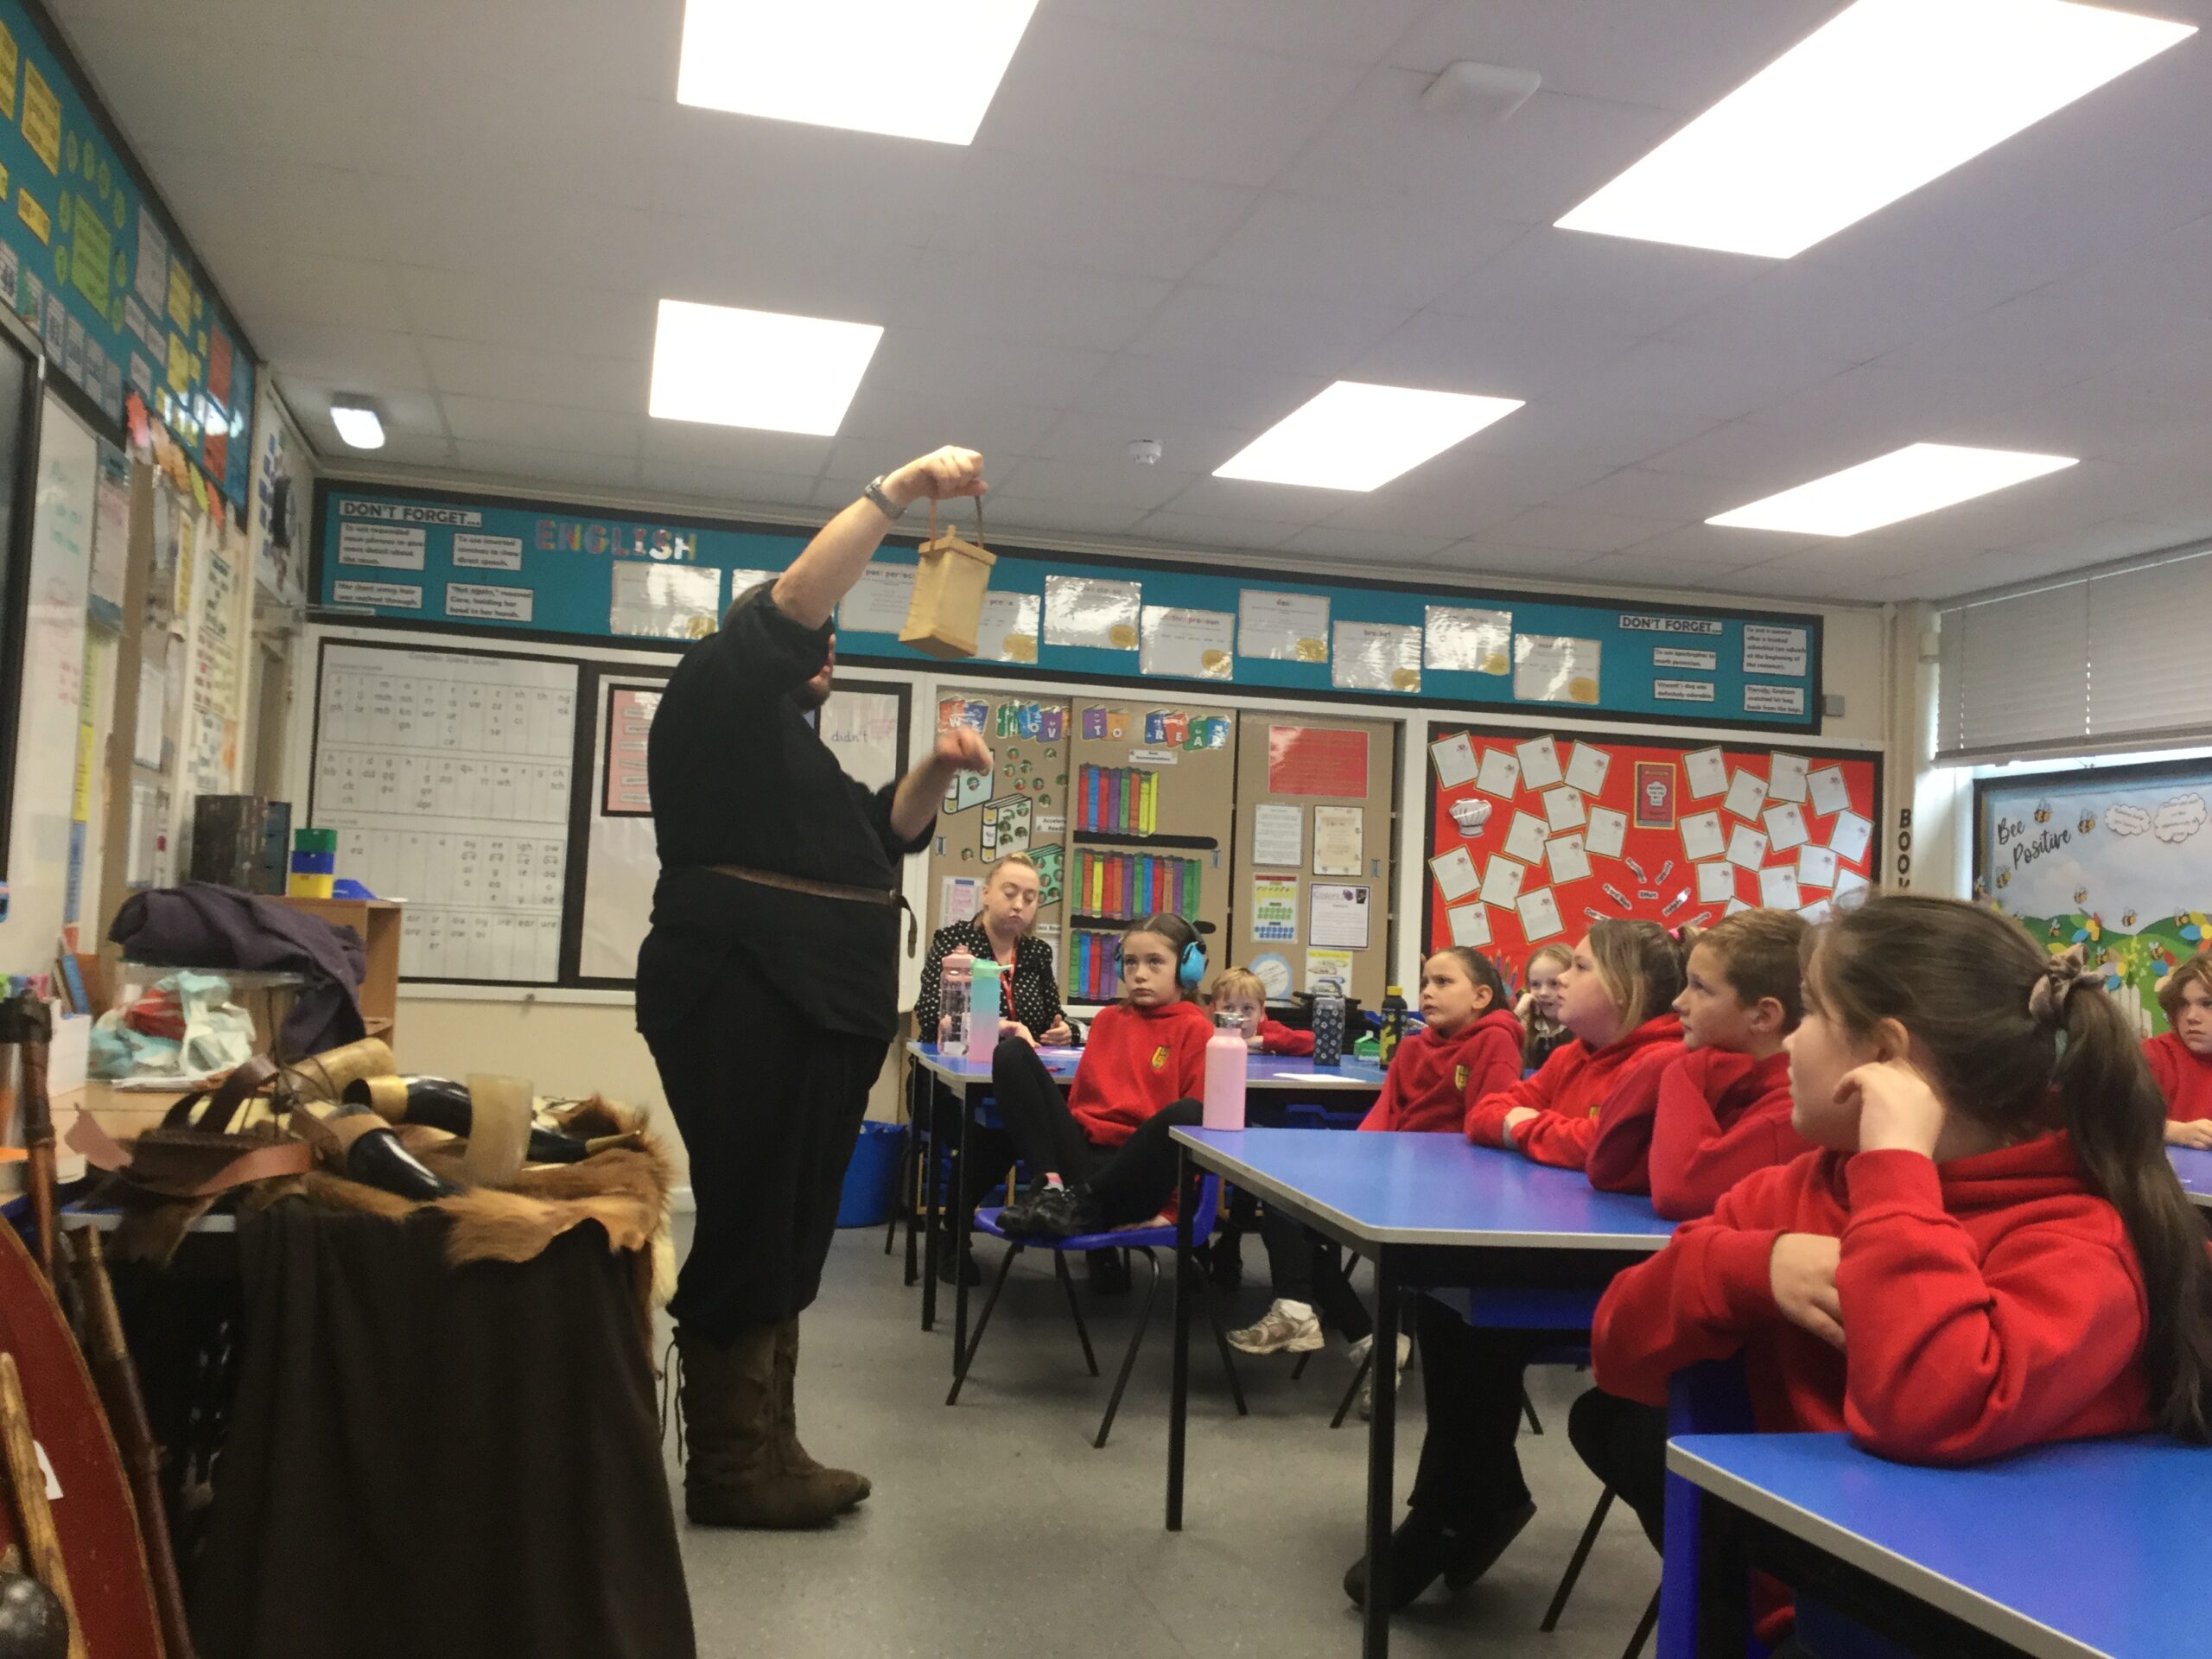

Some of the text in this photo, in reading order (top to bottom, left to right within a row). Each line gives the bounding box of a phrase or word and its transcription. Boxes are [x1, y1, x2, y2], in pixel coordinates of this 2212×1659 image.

[344, 503, 398, 518] DON'T
[536, 520, 696, 560] ENGLISH
[1623, 617, 1660, 629] DON'T
[831, 730, 868, 743] didn't
[1997, 817, 2026, 846] Bee
[2012, 828, 2072, 870] Positive
